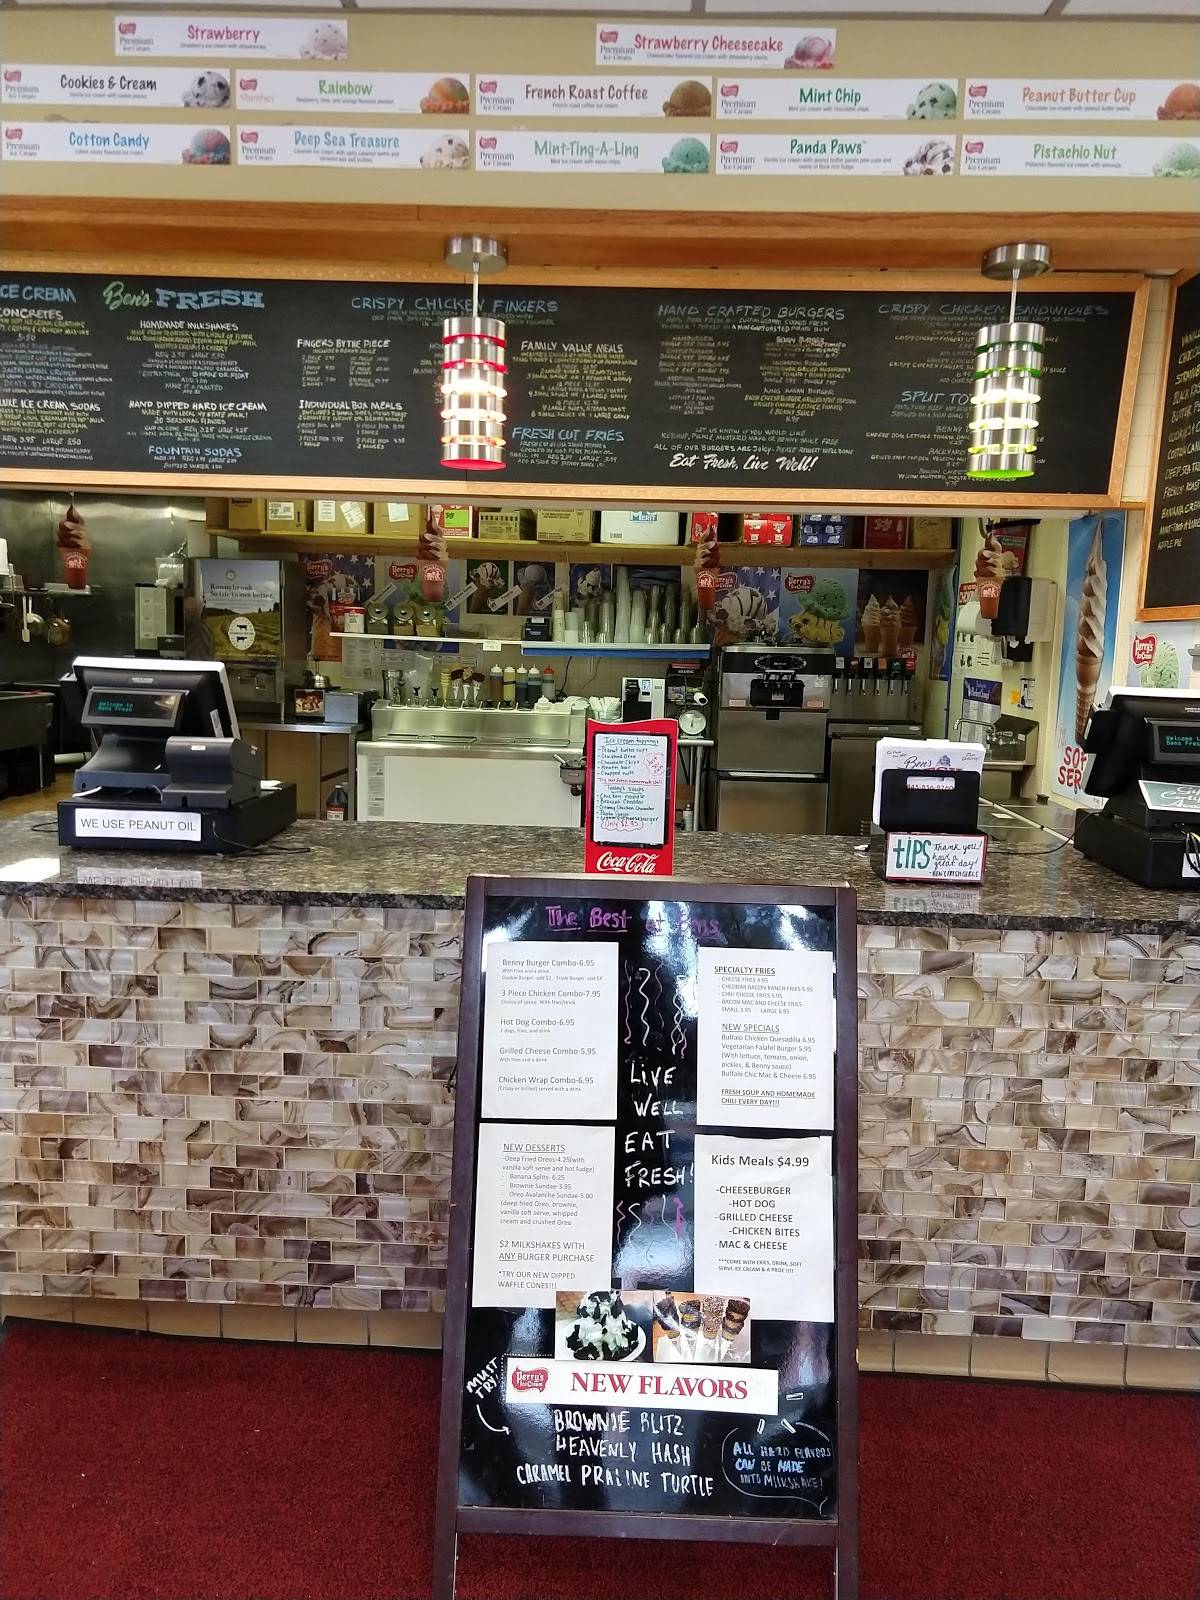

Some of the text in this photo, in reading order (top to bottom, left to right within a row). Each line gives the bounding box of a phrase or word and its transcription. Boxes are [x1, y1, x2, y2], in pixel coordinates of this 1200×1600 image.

[187, 25, 260, 43] Strawberry
[634, 34, 784, 52] Strawberry Cheesecake
[60, 75, 157, 91] Cookies & Cream
[319, 80, 373, 95] Rainbow
[525, 84, 648, 100] French Roast Coffee
[799, 87, 862, 106] Mint Chip
[1022, 87, 1136, 106] Peanut Butter Cup
[968, 100, 1005, 109] Premium
[69, 132, 150, 150] Cotton Candy
[294, 131, 399, 149] Deep Sea Treasure
[790, 138, 863, 155] Panda Paws
[534, 141, 639, 159] Mint-Ting-A-Ling
[1033, 143, 1118, 160] Pistachio Nut
[23, 286, 77, 303] CREAM
[102, 281, 265, 310] Ben's FRESH
[351, 297, 559, 313] CRISPY CHICKEN FINGERS
[657, 304, 845, 321] HAND CRAFTED BURGERS
[878, 302, 1109, 317] CRISPY CHICKEN SANDWICHES
[139, 320, 184, 330] HOMEMADE
[296, 339, 334, 349] FINGERS
[363, 339, 392, 348] PIECE
[520, 340, 624, 354] FAMILY VALUE MEALS
[901, 389, 942, 404] SPLIT
[20, 399, 101, 412] ICE CREAM SODAS
[129, 400, 268, 412] HAND DIPPED HARD ICE CREAM
[298, 400, 351, 411] INDIVIDUAL
[370, 401, 403, 411] MEALS
[511, 427, 626, 442] FRESH CUT FRIES
[148, 445, 242, 458] FOUNTAIN SODAS
[669, 452, 819, 472] Eat Fresh, Live Well!
[392, 565, 416, 576] Perry's
[788, 575, 812, 586] Perry's
[903, 756, 932, 769] Ben's
[81, 818, 197, 832] WE USE PEANUT OIL
[932, 843, 961, 852] Thank
[962, 840, 983, 854] you!
[596, 851, 660, 874] Coca-Cola
[933, 859, 979, 870] great day!
[545, 904, 630, 930] The Best
[502, 959, 595, 968] Benny Burger Combo-6.95
[714, 966, 776, 976] SPECIALTY FRIES
[501, 989, 601, 998] 3 Piece Chicken Combo-7.95
[500, 1018, 575, 1028] Hot Dog Combo-6.95
[722, 1023, 780, 1033] NEW SPECIALS
[499, 1047, 597, 1056] Grilled Cheese Combo-5.95
[498, 1076, 595, 1085] Chicken Wrap Combo-6.95
[633, 1092, 684, 1118] WELL
[503, 1143, 566, 1153] NEW DESSERTS
[624, 1129, 676, 1154] EAT
[711, 1154, 809, 1169] Kids Meals $4.99
[624, 1161, 696, 1190] FRESH!
[715, 1185, 792, 1195] -CHEESEBURGER
[728, 1199, 776, 1208] -HOT DOG
[714, 1212, 793, 1223] -GRILLED CHEESE
[728, 1226, 801, 1238] -CHICKEN BITES
[499, 1240, 585, 1250] $2 MILKSHAKES WITH
[743, 1240, 751, 1249] &
[753, 1241, 788, 1251] CHEESE
[498, 1252, 595, 1263] ANY BURGER PURCHASE
[465, 1356, 500, 1393] MUST
[516, 1371, 545, 1386] Perry's
[474, 1373, 501, 1401] TRY!
[570, 1372, 748, 1400] NEW FLAVORS
[552, 1408, 631, 1433] BROWNIE
[555, 1433, 691, 1467] HEAVENLY HASH
[732, 1441, 754, 1457] ALL
[734, 1459, 806, 1474] CAN BE MADE
[516, 1462, 715, 1497] CARAMEL PRALINE TURTLE
[739, 1472, 762, 1485] INTO
